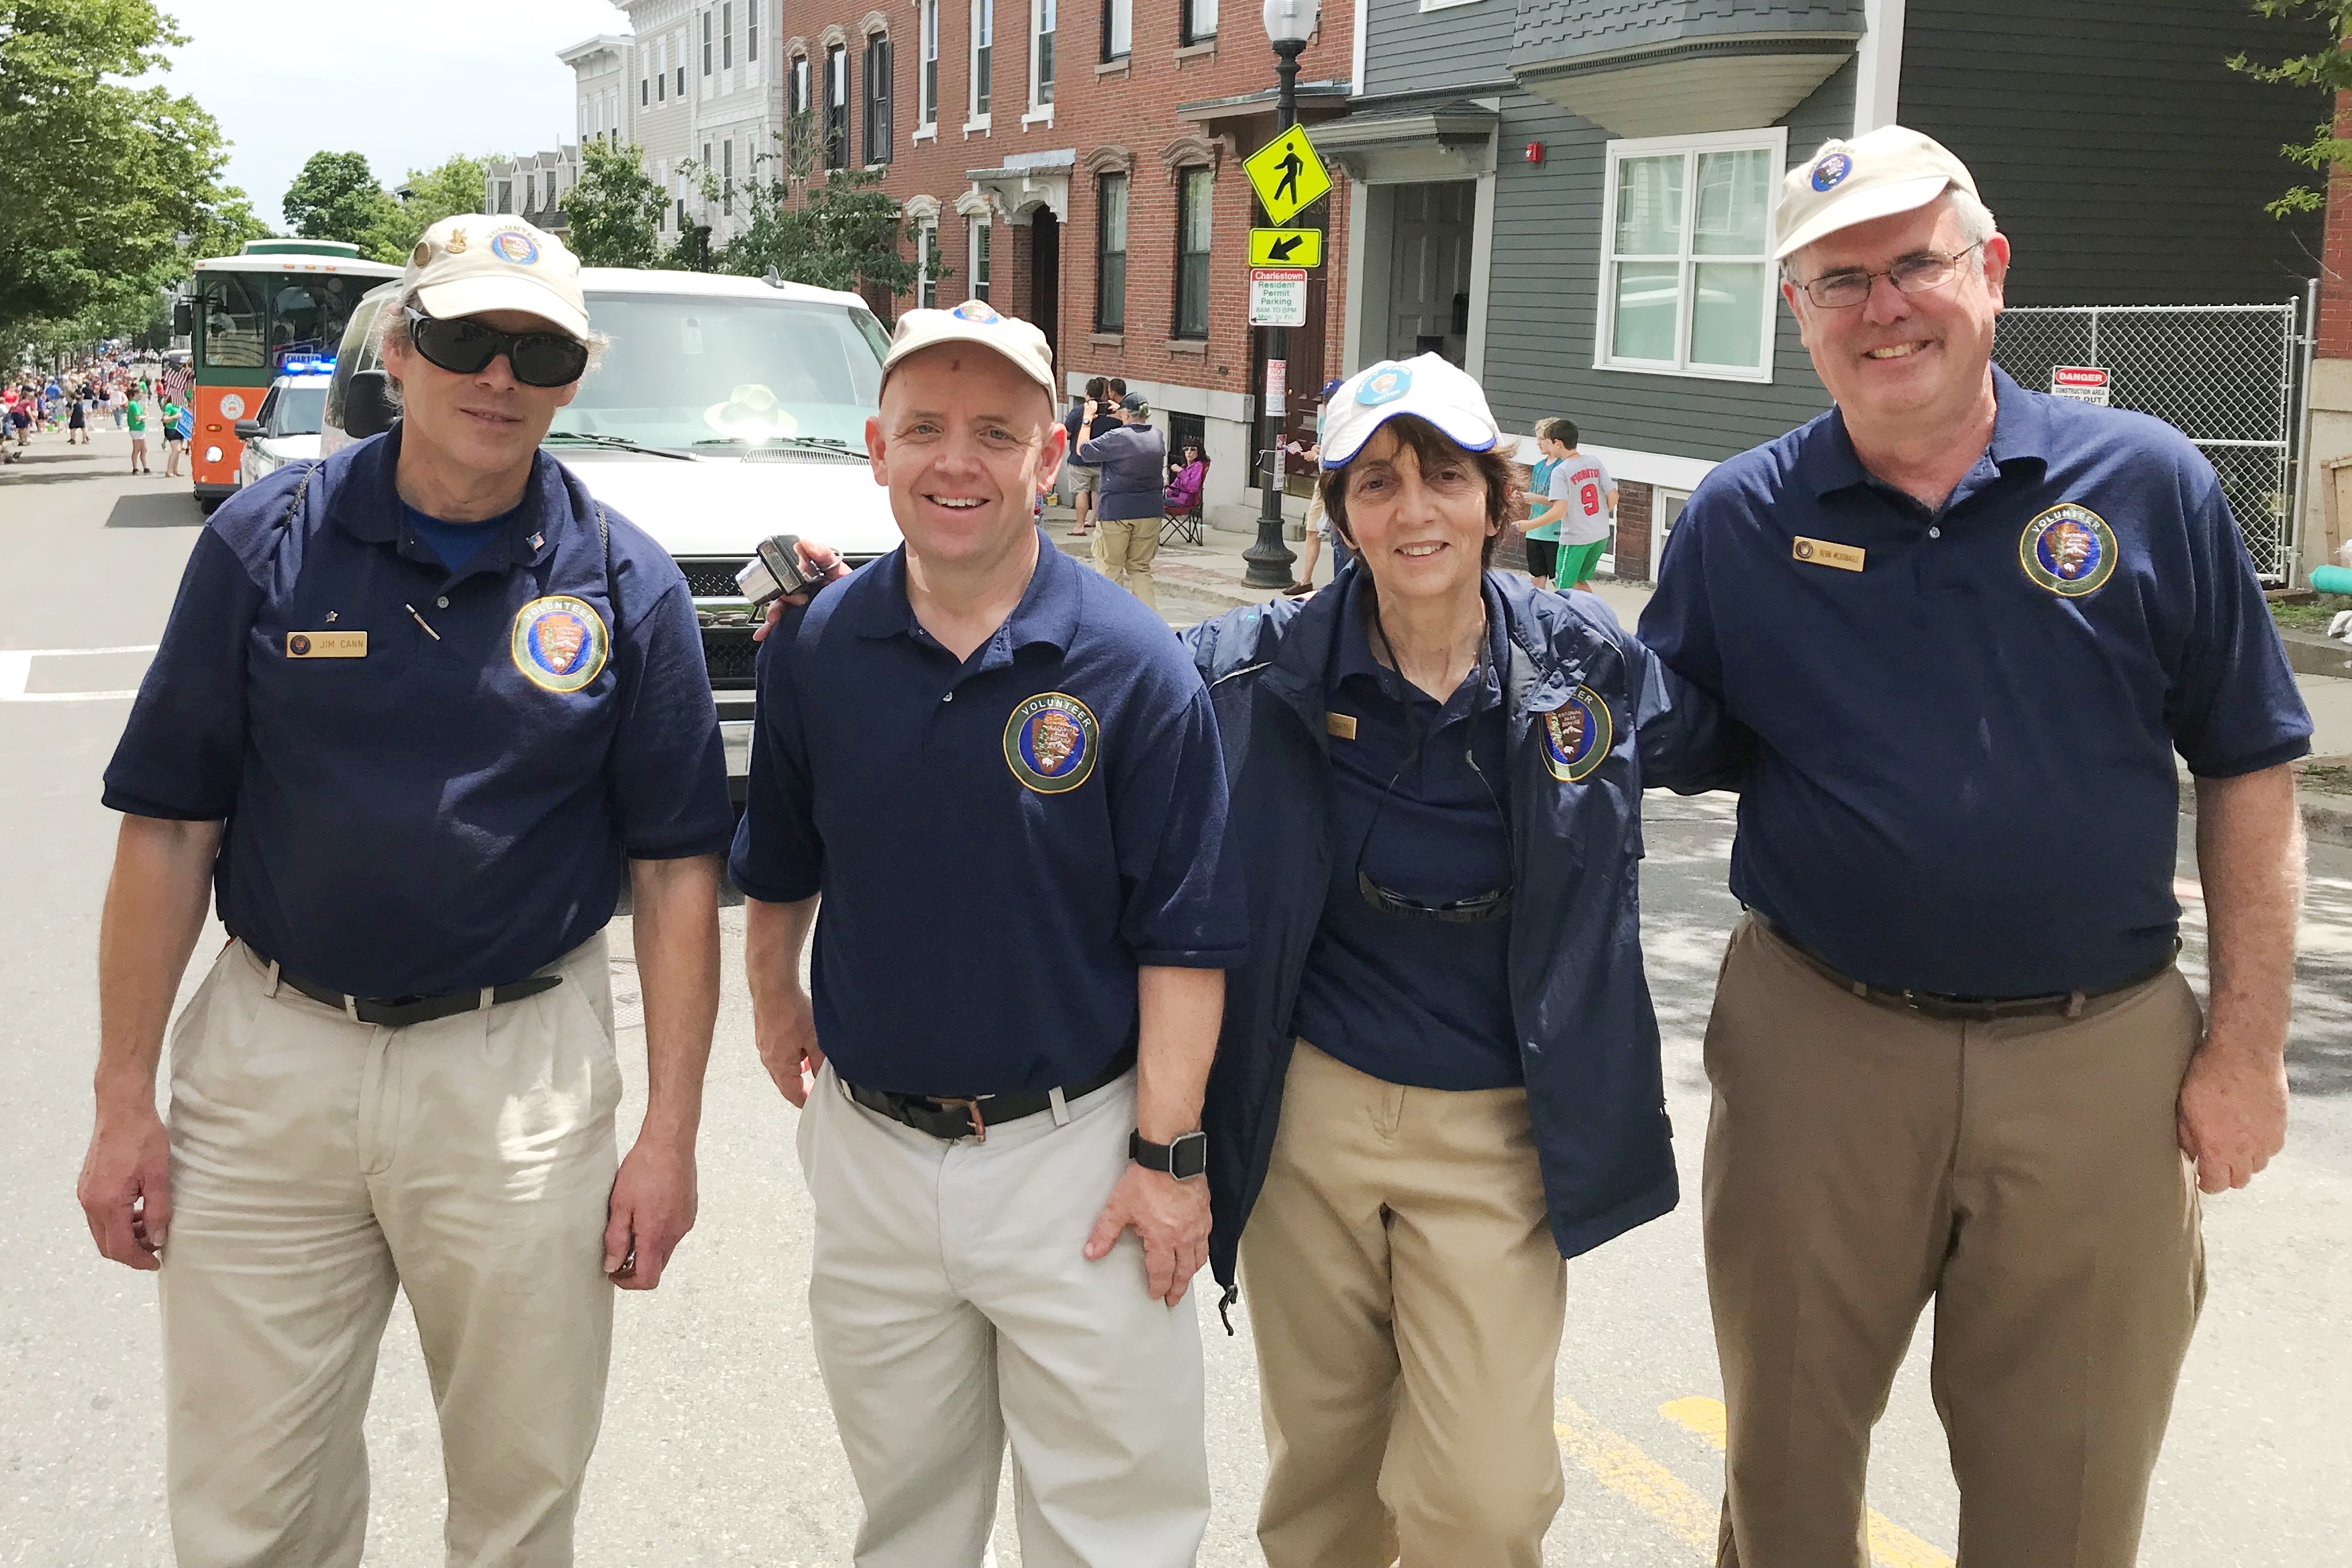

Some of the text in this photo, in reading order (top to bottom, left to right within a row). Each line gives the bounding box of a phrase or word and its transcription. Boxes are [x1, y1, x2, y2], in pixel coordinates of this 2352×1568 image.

[485, 225, 543, 249] VOLUNTEER
[1255, 271, 1303, 280] Charlestown
[1261, 298, 1292, 306] Parking
[1358, 366, 1410, 393] NAVY YARD
[2059, 372, 2102, 382] DANGER
[1373, 389, 1400, 403] BOSTON
[1580, 483, 1599, 516] 9
[2031, 509, 2100, 532] VOLUNTEER
[523, 602, 595, 623] VOLUNTEER
[320, 640, 363, 649] JIM CANN
[1021, 698, 1092, 727] VOLUNTEER
[1557, 710, 1582, 718] NATIONAL
